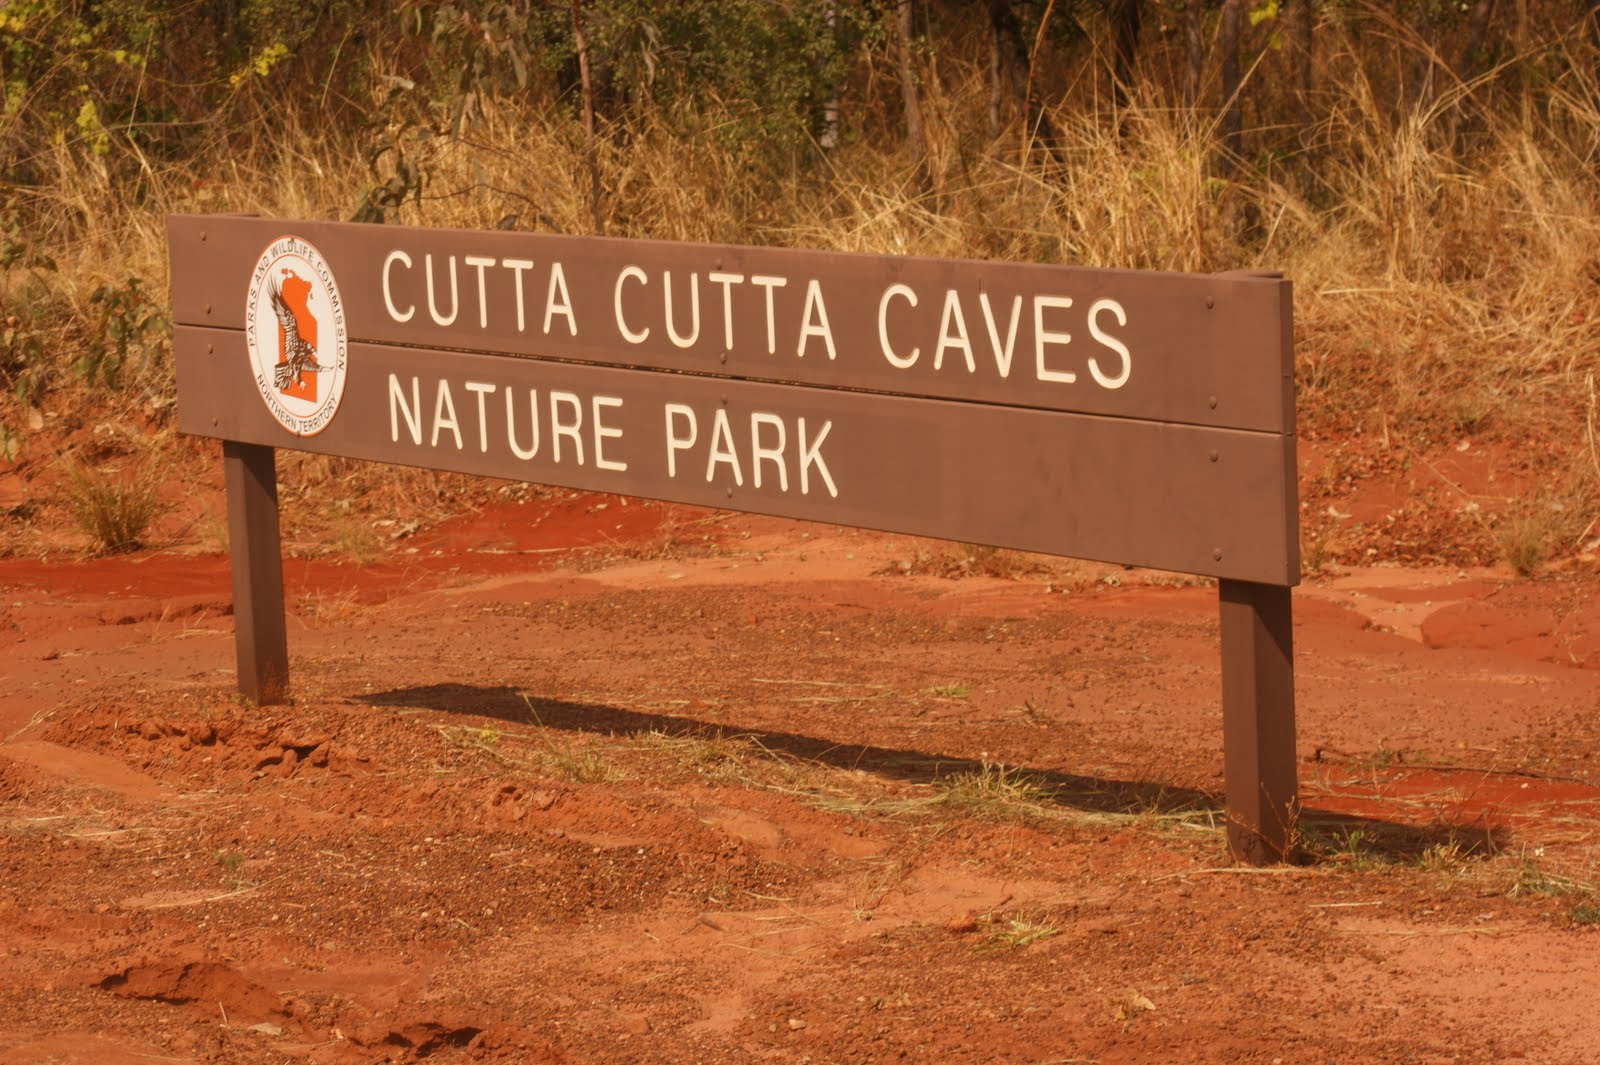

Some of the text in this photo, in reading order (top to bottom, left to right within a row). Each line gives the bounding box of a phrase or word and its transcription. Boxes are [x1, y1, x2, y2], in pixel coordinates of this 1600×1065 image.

[248, 240, 345, 371] PARKS AND WILDLIFE COMMISSION
[382, 250, 1131, 389] CUTTA CUTTA CAVES
[257, 374, 338, 433] NORTHERN TERRITORY
[389, 373, 838, 498] NATURE PARK
